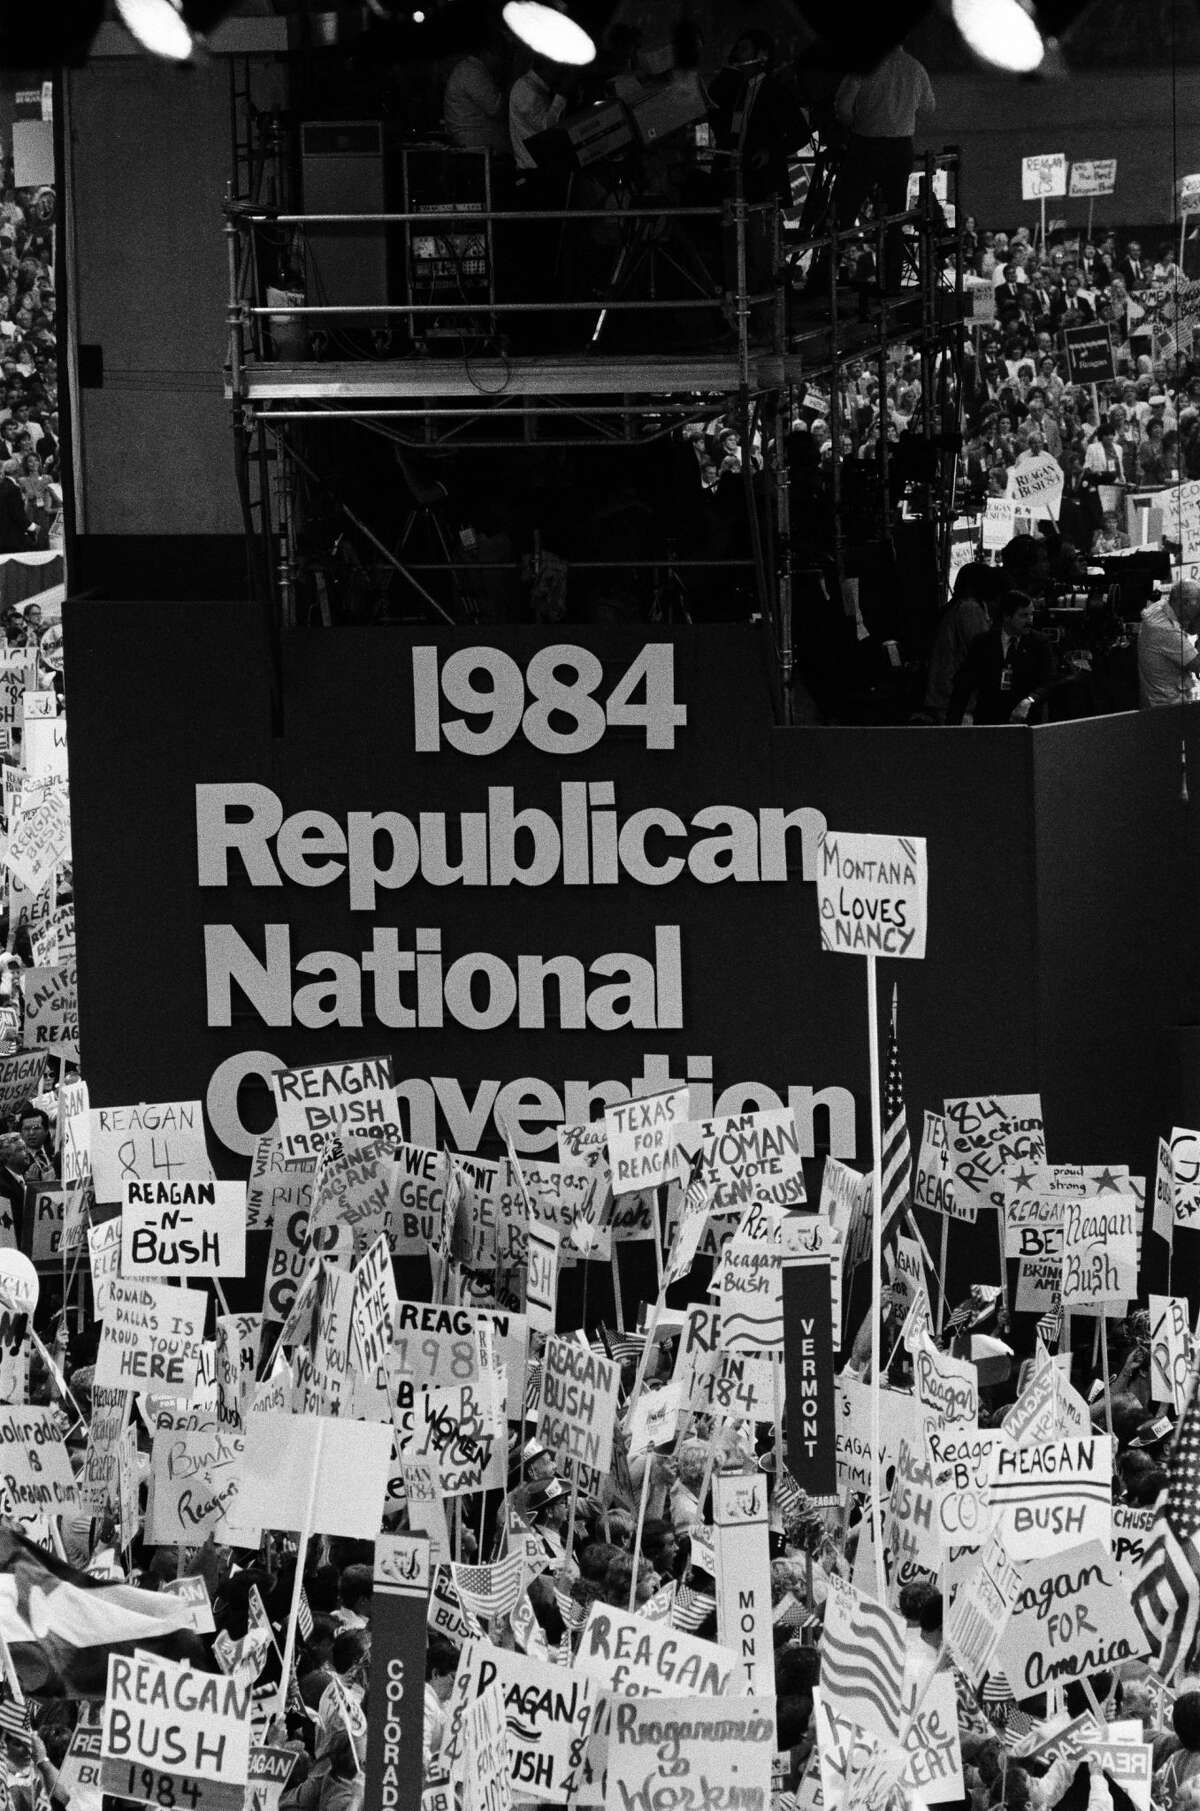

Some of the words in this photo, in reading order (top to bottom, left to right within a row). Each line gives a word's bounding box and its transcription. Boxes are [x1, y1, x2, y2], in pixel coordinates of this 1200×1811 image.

[411, 643, 688, 756] 1984
[195, 780, 829, 911] Republican
[823, 838, 917, 885] MONTANA
[839, 886, 907, 928] LOVES
[835, 918, 916, 955] NANCY
[203, 922, 684, 1031] National
[277, 1058, 394, 1102] REAGAN
[99, 1105, 195, 1131] REAGAN
[206, 1051, 857, 1159] Cnvenin
[305, 1099, 386, 1131] BUSH
[612, 1095, 676, 1133] TEXAS
[286, 1130, 338, 1156] 198
[634, 1130, 664, 1150] FOR
[701, 1122, 715, 1139] I
[725, 1115, 755, 1133] AM
[253, 1137, 274, 1178] WITH
[405, 1146, 438, 1181] WE
[708, 1168, 721, 1184] I
[730, 1157, 783, 1180] VOTE
[1053, 1166, 1085, 1177] proud
[128, 1181, 216, 1206] REAGAN
[1049, 1181, 1087, 1195] strong
[723, 1271, 770, 1294] Bush
[1063, 1253, 1121, 1297] Bush
[104, 1326, 139, 1346] PROUD
[116, 1308, 159, 1330] DALLAS
[170, 1316, 194, 1336] IS
[399, 1303, 510, 1338] REAGN
[120, 1350, 184, 1383] HERE
[547, 1340, 613, 1393] REAGAN
[722, 1357, 745, 1381] IN
[543, 1372, 595, 1425] BUSH
[800, 1317, 819, 1459] VERMONT
[539, 1414, 600, 1470] AGAIN
[929, 1433, 1001, 1470] Reaga
[562, 1455, 602, 1497] BSH
[1013, 1504, 1087, 1535] BUSH
[1047, 1603, 1098, 1648] FOR
[587, 1614, 732, 1697] REAGAN
[111, 1657, 251, 1721] REAGAN
[610, 1665, 663, 1698] for
[107, 1708, 227, 1773] BUSH
[127, 1764, 204, 1811] 1984
